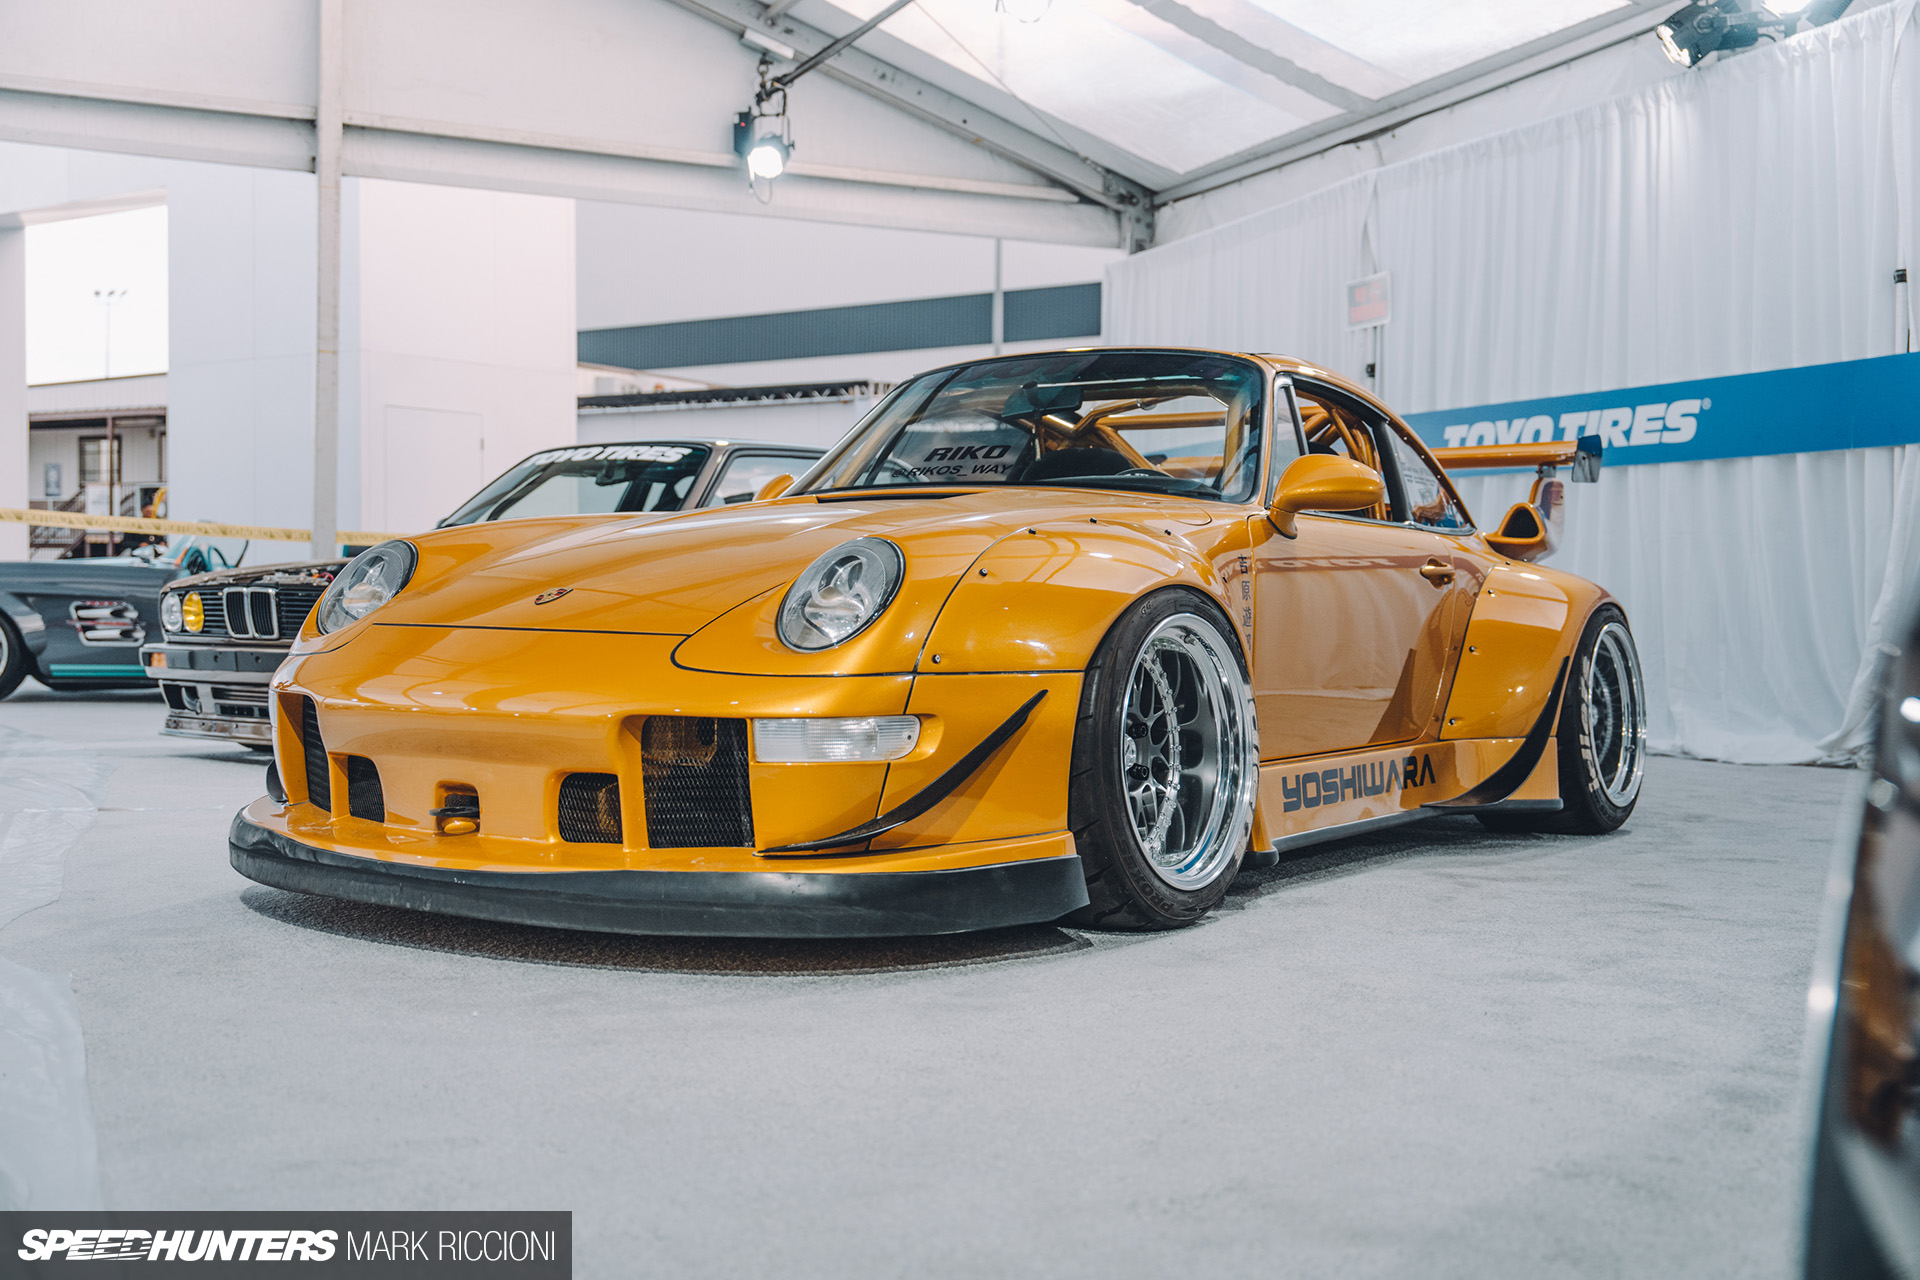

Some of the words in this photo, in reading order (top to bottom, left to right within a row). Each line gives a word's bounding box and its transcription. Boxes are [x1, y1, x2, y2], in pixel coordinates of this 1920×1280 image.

[1443, 414, 1554, 448] TOYO
[1558, 398, 1702, 448] TIRES
[594, 445, 693, 463] TIRES
[923, 444, 1012, 462] RIKO
[891, 463, 1014, 479] @RIKOS_WAY
[1281, 752, 1437, 813] YOSHIWARA
[1119, 840, 1175, 913] PROXES
